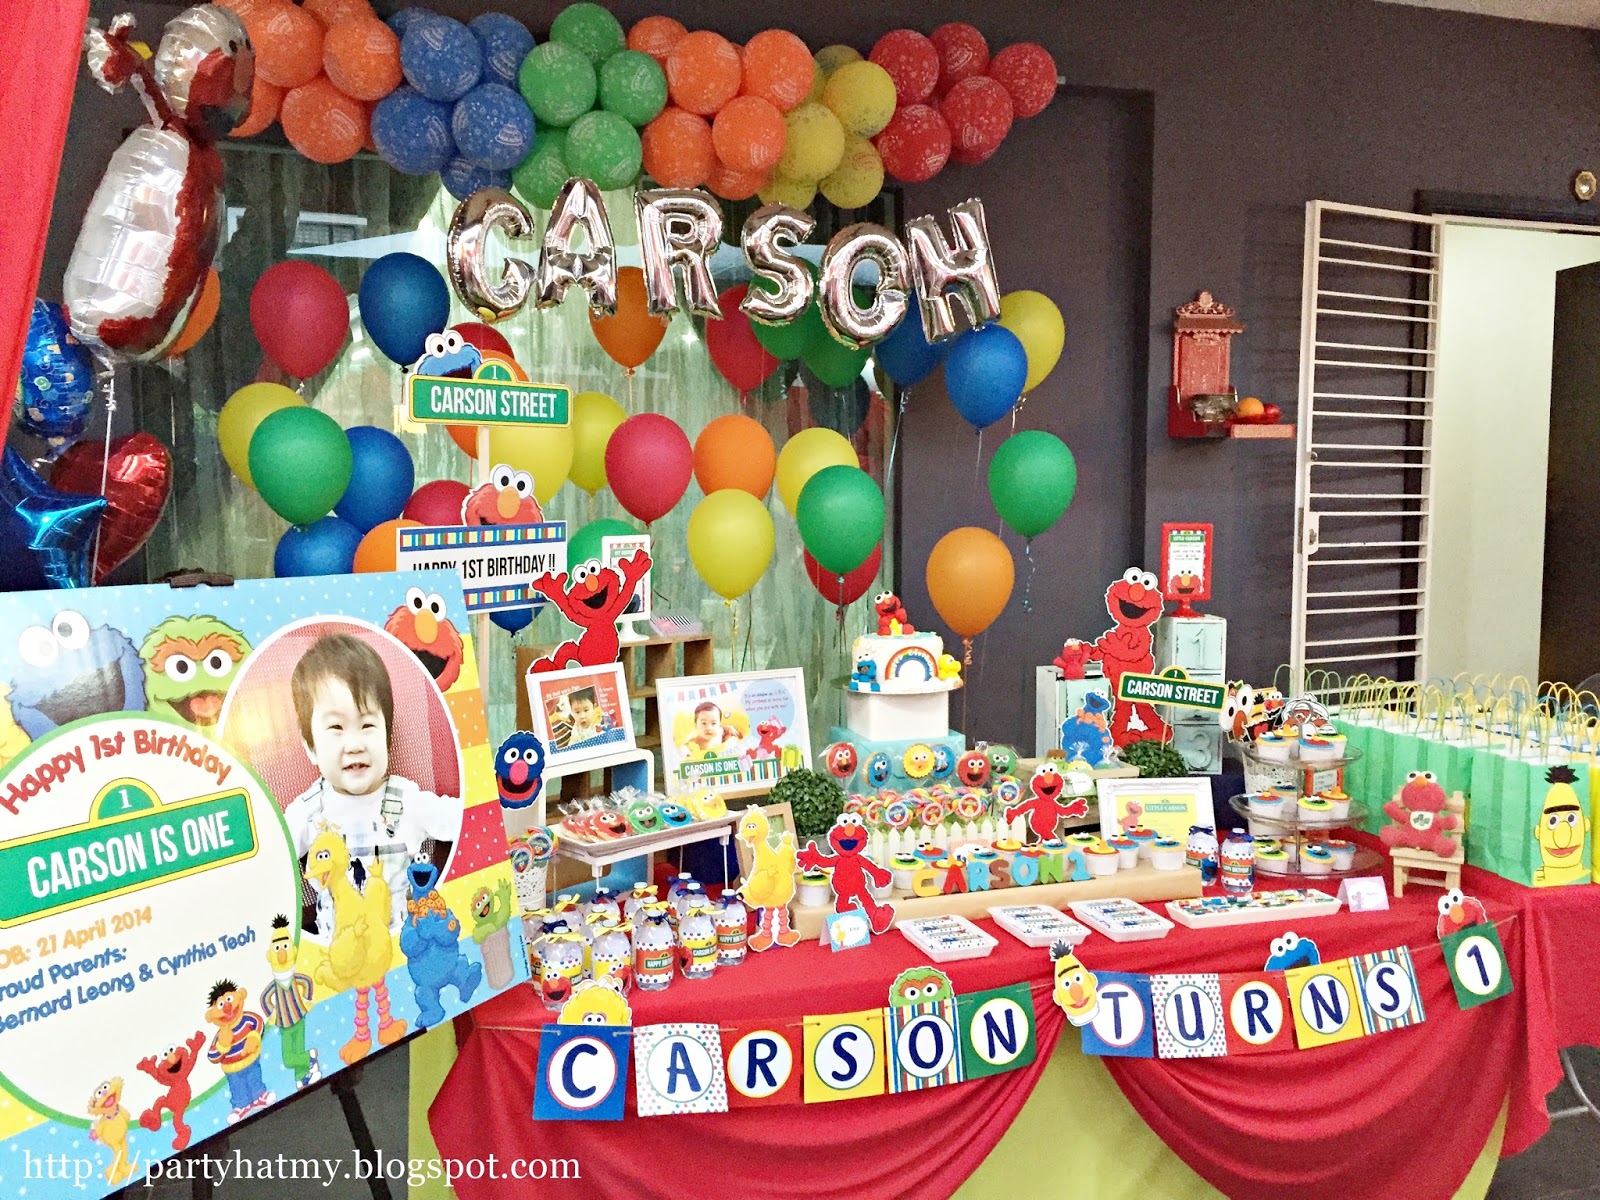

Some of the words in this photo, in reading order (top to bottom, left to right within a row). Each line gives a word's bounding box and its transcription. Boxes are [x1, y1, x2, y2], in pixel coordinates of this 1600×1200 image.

[446, 176, 1002, 350] CARSON
[491, 365, 498, 380] 1
[430, 385, 497, 417] CARSON
[500, 391, 558, 419] STREET
[461, 559, 484, 579] 1ST
[487, 554, 546, 577] BIRTHDAY
[1127, 679, 1173, 699] CARSON
[1174, 686, 1219, 705] STREET
[0, 745, 85, 815] Happy
[90, 731, 125, 760] 1st
[133, 729, 232, 786] Birthday
[715, 761, 723, 773] IS
[723, 760, 738, 772] ONE
[118, 788, 132, 809] 1
[27, 831, 148, 899] CARSON
[149, 824, 179, 866] IS
[181, 810, 234, 857] ONE
[912, 854, 1064, 897] CARSON
[36, 934, 57, 957] 21
[63, 920, 106, 949] April
[110, 905, 153, 934] 2014
[48, 947, 127, 985] Parents:
[77, 972, 135, 1006] Leong
[139, 963, 154, 982] &
[157, 943, 217, 976] Cynthia
[218, 925, 256, 952] Teoh
[561, 1008, 1019, 1099] CARSON
[1101, 967, 1400, 1042] TURNS
[1466, 944, 1490, 987] 1
